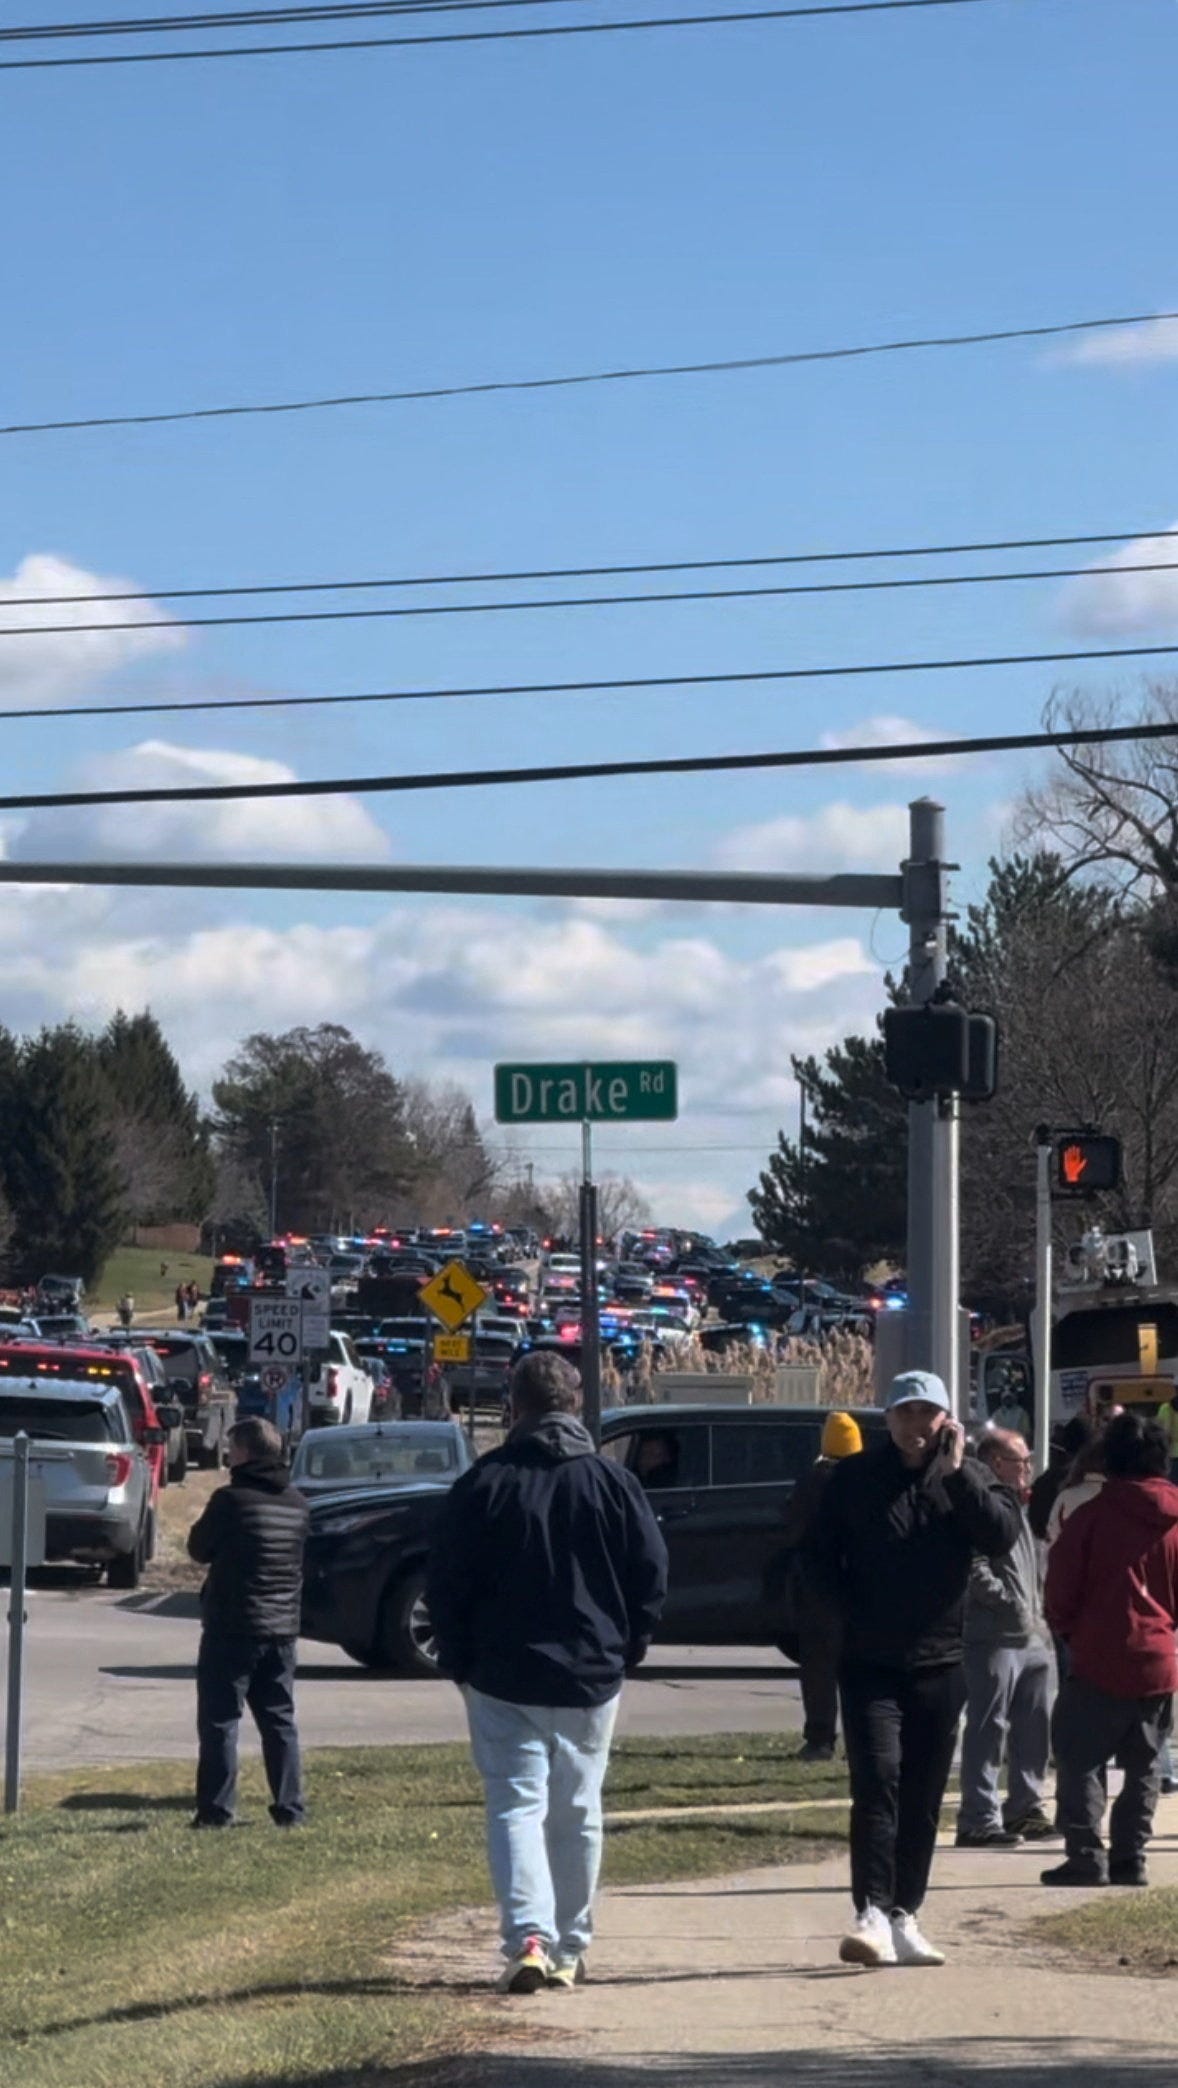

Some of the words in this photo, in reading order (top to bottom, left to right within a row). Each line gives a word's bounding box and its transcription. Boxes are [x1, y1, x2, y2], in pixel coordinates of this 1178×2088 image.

[511, 1067, 628, 1115] Drake
[640, 1070, 665, 1094] Rd
[254, 1304, 299, 1316] SPEED
[259, 1318, 293, 1329] LIMIT
[254, 1331, 298, 1356] 40
